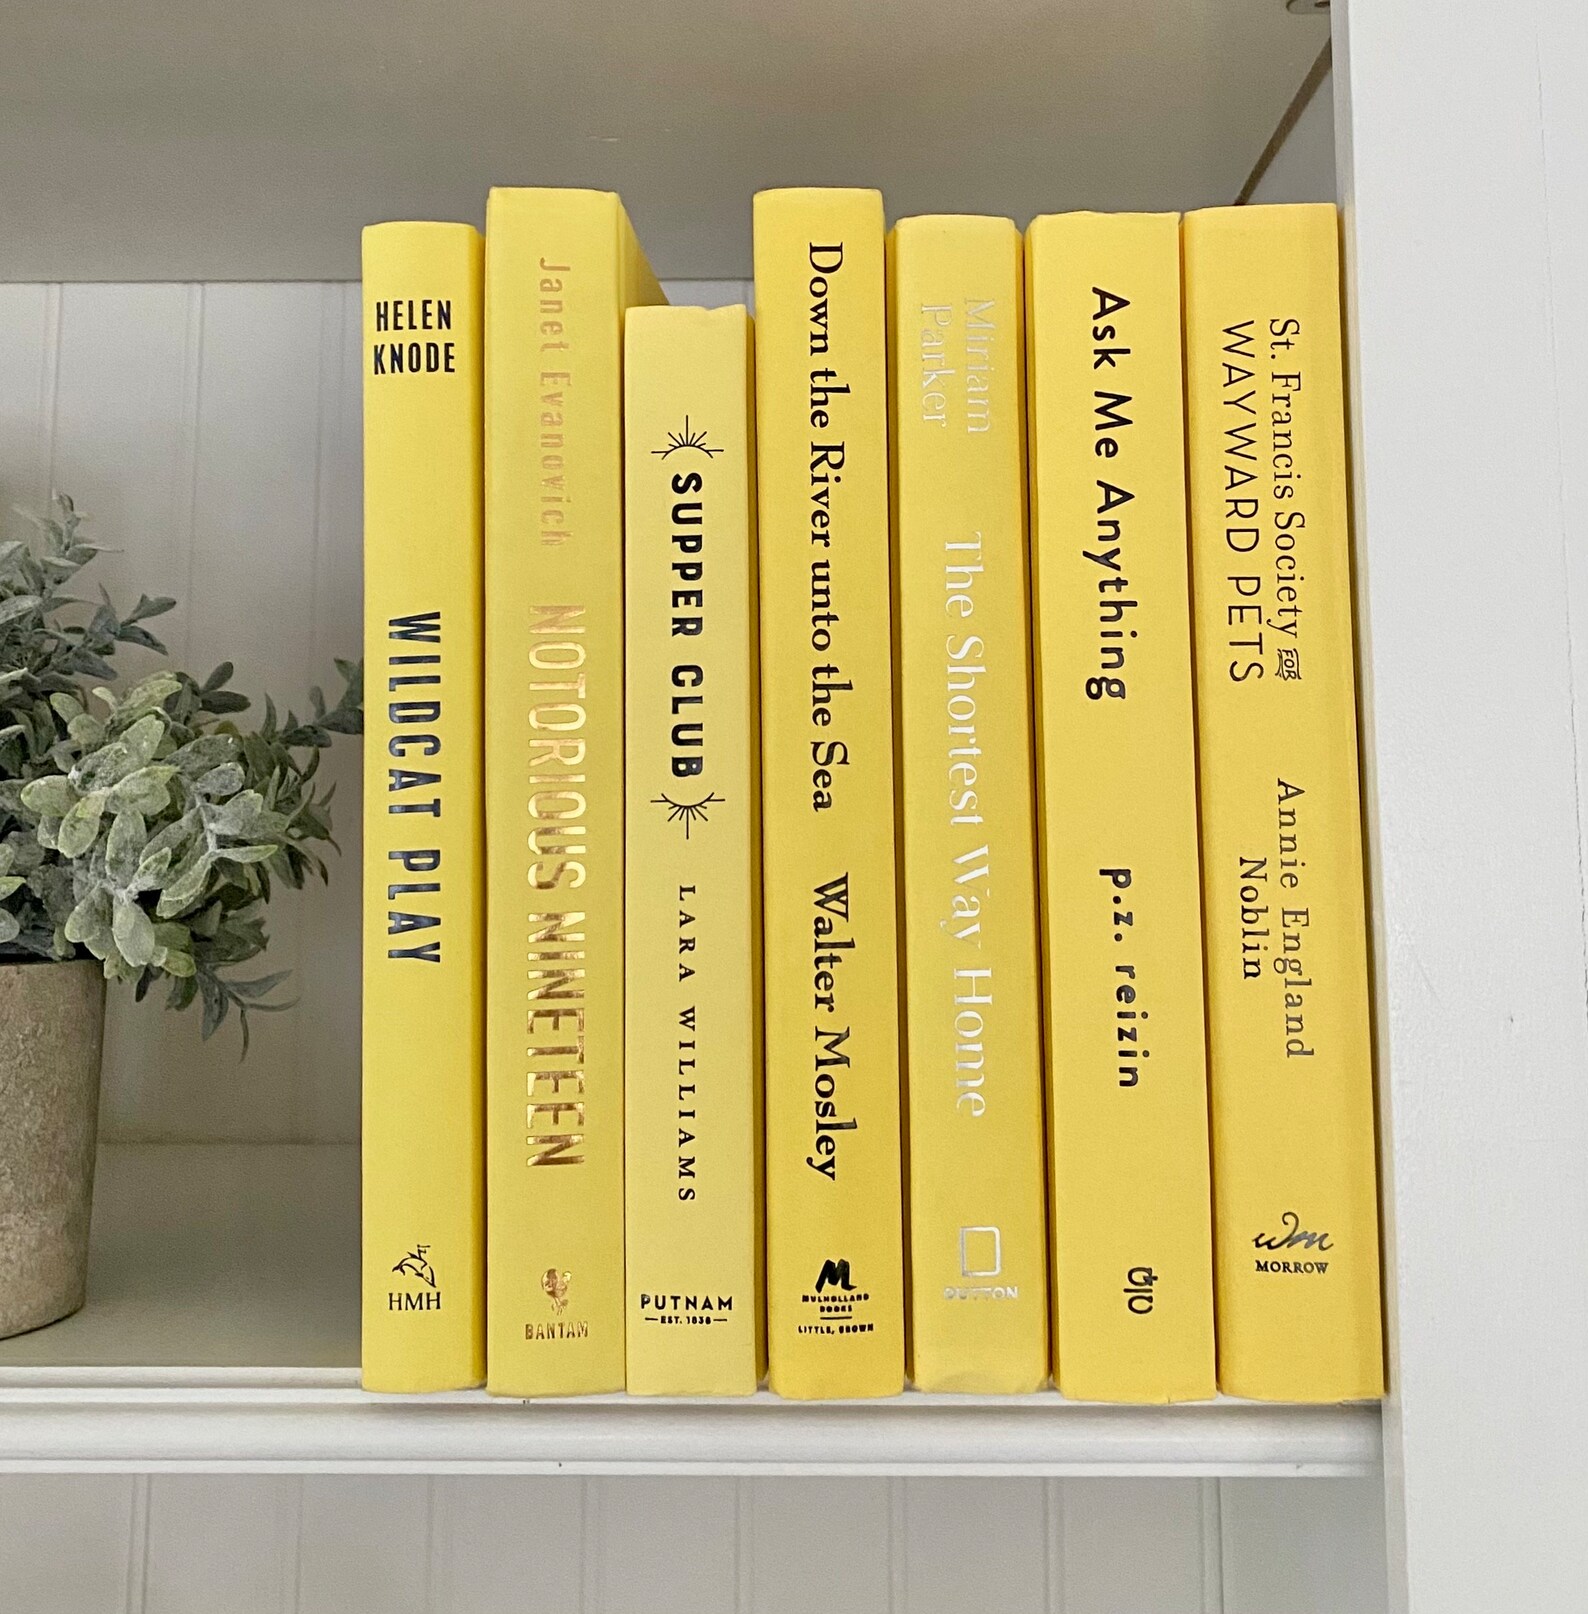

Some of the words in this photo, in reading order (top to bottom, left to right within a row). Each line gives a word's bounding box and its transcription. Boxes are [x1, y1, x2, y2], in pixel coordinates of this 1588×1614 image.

[376, 299, 451, 331] HELEN
[539, 257, 570, 353] Janet
[809, 241, 844, 357] Down
[1092, 286, 1131, 370] Ask
[1269, 318, 1300, 360] St.
[373, 342, 456, 375] KNODE
[810, 366, 850, 428] the
[921, 302, 955, 429] Parker
[965, 298, 996, 434] Miriam
[540, 371, 573, 547] Evanovich
[1094, 390, 1133, 459] Me
[1221, 320, 1260, 553] WAYWARD
[1270, 371, 1301, 500] Francis
[810, 441, 846, 548] River
[672, 472, 703, 637] SUPPER
[812, 559, 839, 652] unto
[944, 531, 985, 618] The
[1083, 480, 1138, 701] Anything
[1267, 511, 1306, 639] Society
[1227, 575, 1263, 683] PETS
[1281, 649, 1297, 681] FOR
[388, 611, 441, 817] WILDCAT
[527, 605, 586, 890] NOTORIOUS
[672, 664, 703, 778] CLUB
[812, 663, 853, 726] the
[945, 633, 987, 827] Shortest
[811, 740, 849, 811] Sea
[1277, 778, 1305, 889] Annie
[388, 849, 441, 963] PLAY
[679, 884, 696, 982] LARA
[813, 871, 855, 1010] Walter
[940, 844, 990, 949] Way
[1099, 868, 1133, 943] p.z.
[1239, 857, 1269, 980] Noblin
[1115, 965, 1150, 1088] reizin
[1273, 906, 1314, 1059] England
[527, 912, 585, 1166] NINETEEN
[953, 967, 992, 1118] Home
[678, 1006, 696, 1202] WILLIAMS
[807, 1026, 857, 1181] Mosley
[388, 1292, 440, 1311] HMH
[641, 1294, 733, 1310] PUTNAM
[660, 1315, 682, 1325] EST.
[801, 1292, 870, 1303] MULHOLLAND
[819, 1304, 853, 1313] BOOKS
[943, 1286, 1018, 1301] DUTTON
[1255, 1260, 1329, 1275] MORROW
[525, 1320, 588, 1340] BANTAM
[798, 1325, 835, 1335] LITTLE,
[838, 1323, 874, 1334] BROWN
